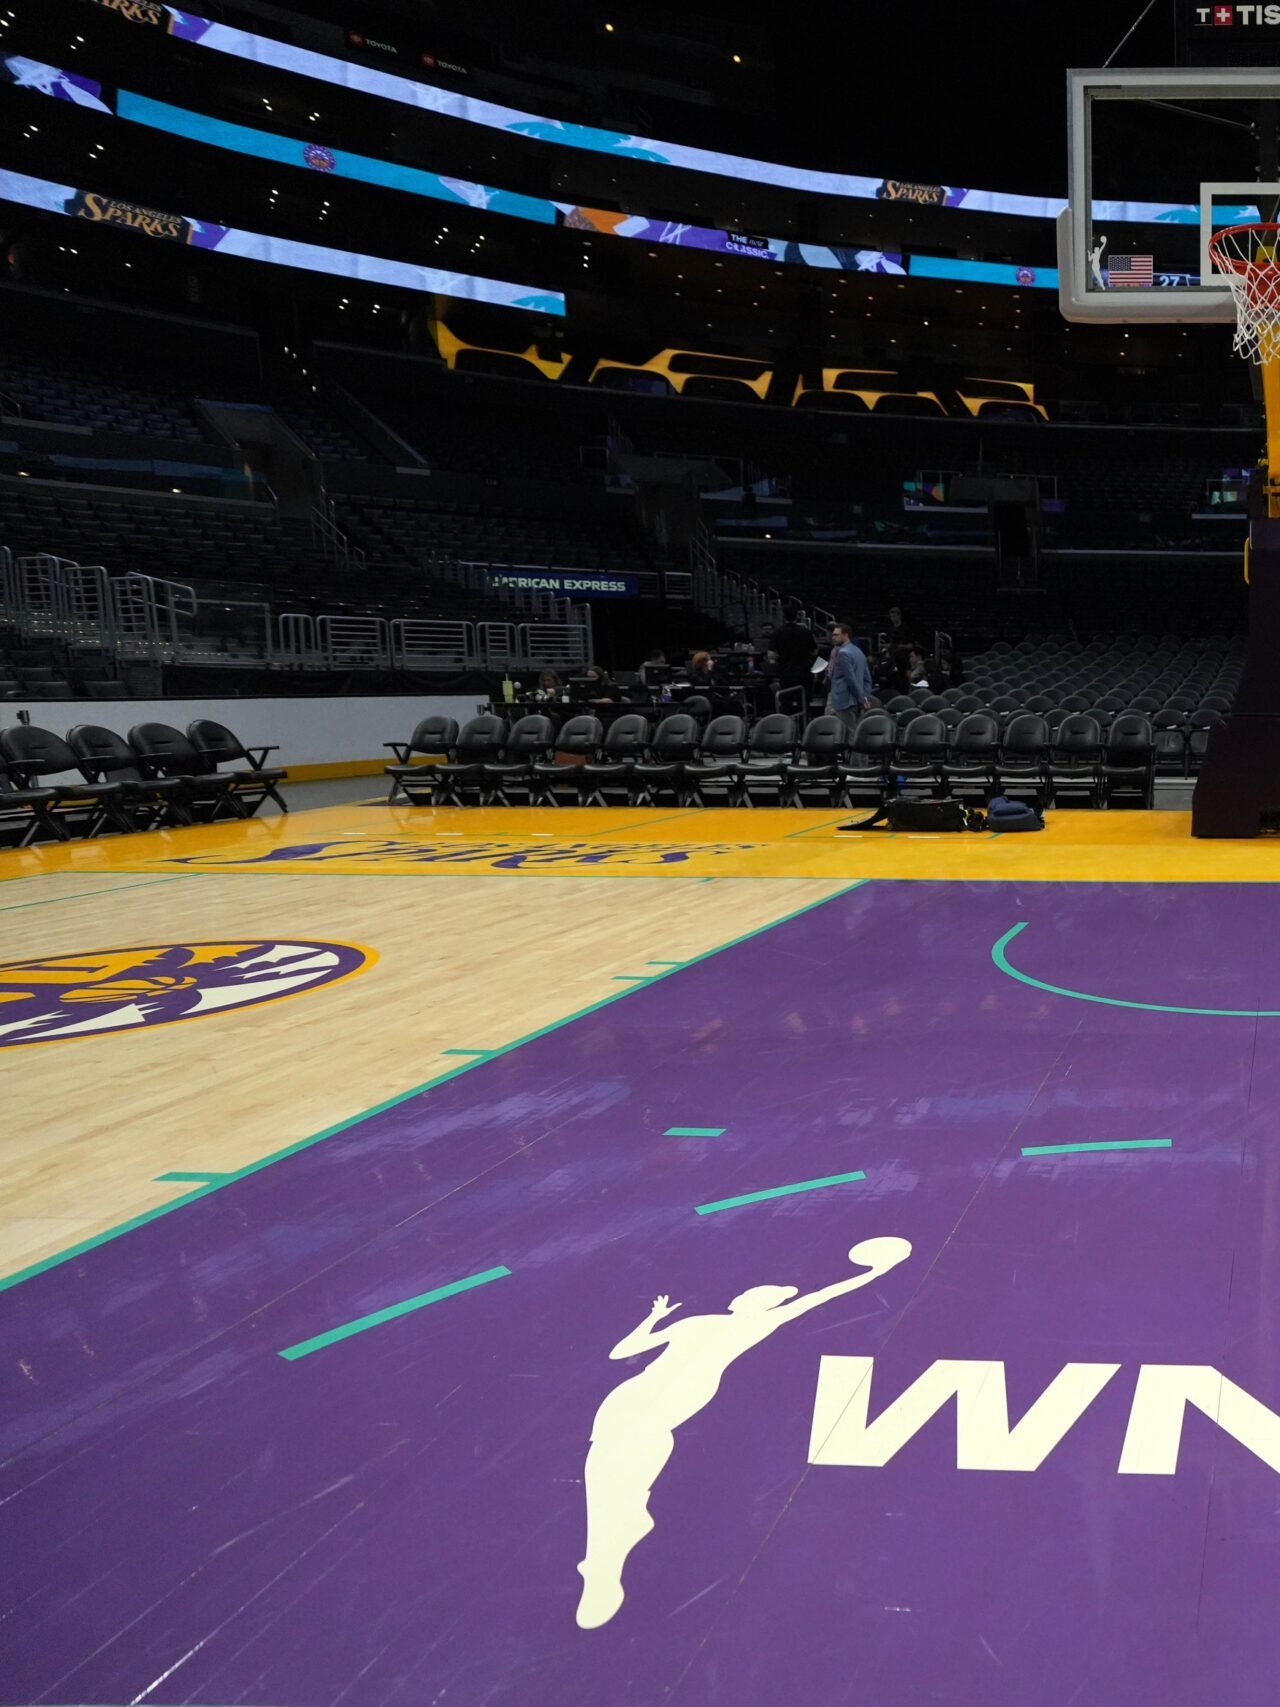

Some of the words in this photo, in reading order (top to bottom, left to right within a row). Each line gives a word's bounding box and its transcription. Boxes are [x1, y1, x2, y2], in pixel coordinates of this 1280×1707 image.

[366, 39, 398, 53] TOYOTA
[437, 60, 467, 74] TOYOTA
[882, 180, 940, 204] SPARKS
[78, 193, 181, 237] SPARKS
[731, 233, 748, 244] THE
[1159, 275, 1180, 287] 27
[563, 580, 626, 591] EXPRESS
[152, 840, 728, 870] SPARKS
